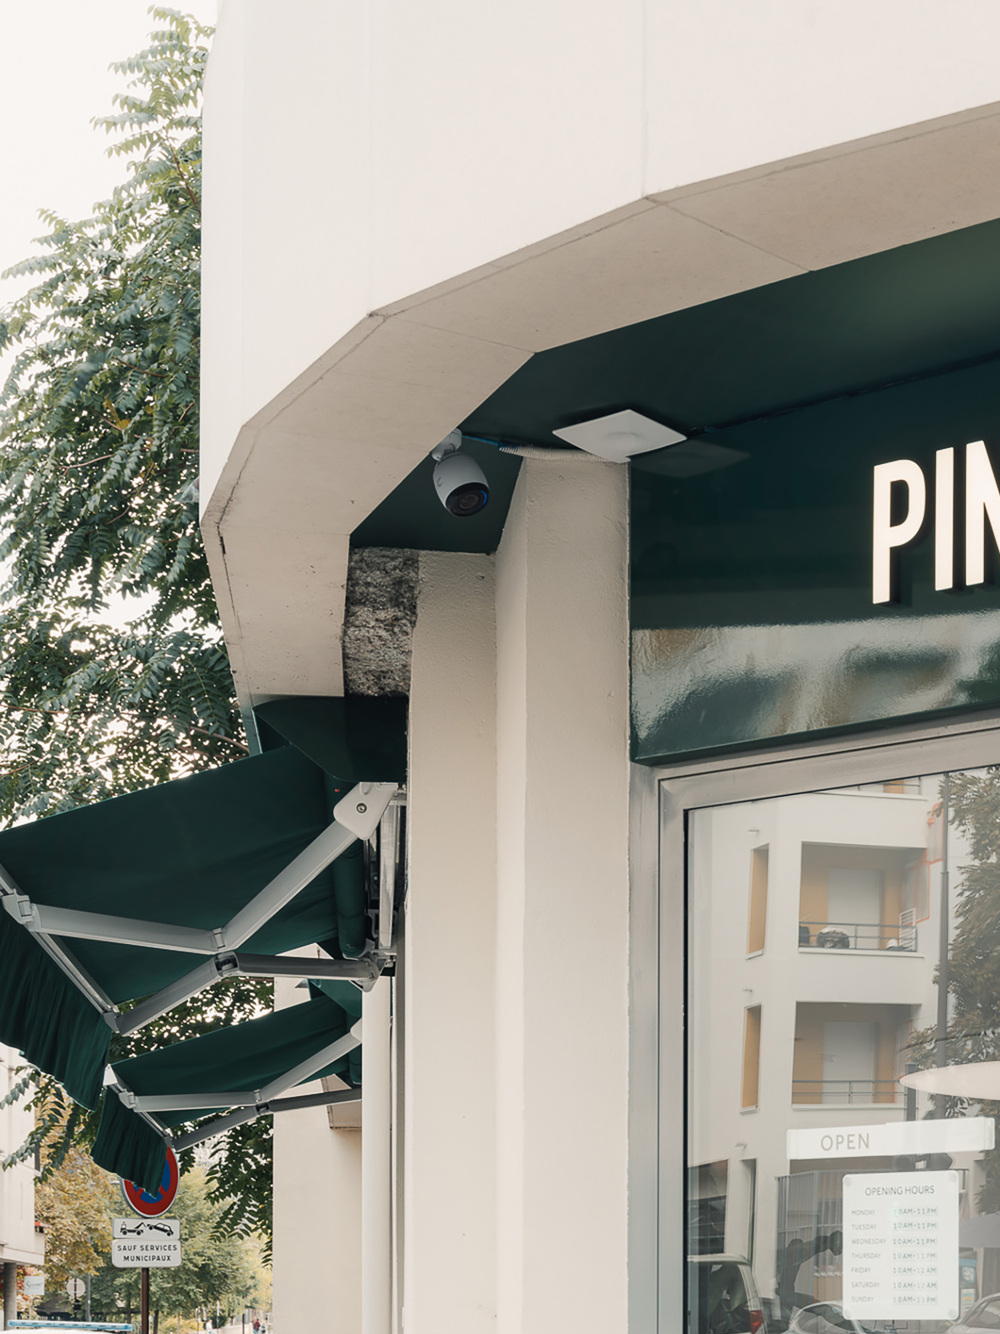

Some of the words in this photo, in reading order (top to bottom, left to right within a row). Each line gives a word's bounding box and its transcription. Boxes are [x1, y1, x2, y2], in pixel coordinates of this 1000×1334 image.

[821, 1133, 870, 1151] OPEN
[865, 1186, 903, 1196] OPENING
[905, 1185, 935, 1195] HOURS
[117, 1244, 138, 1252] SAUF
[140, 1244, 178, 1252] SERVICES
